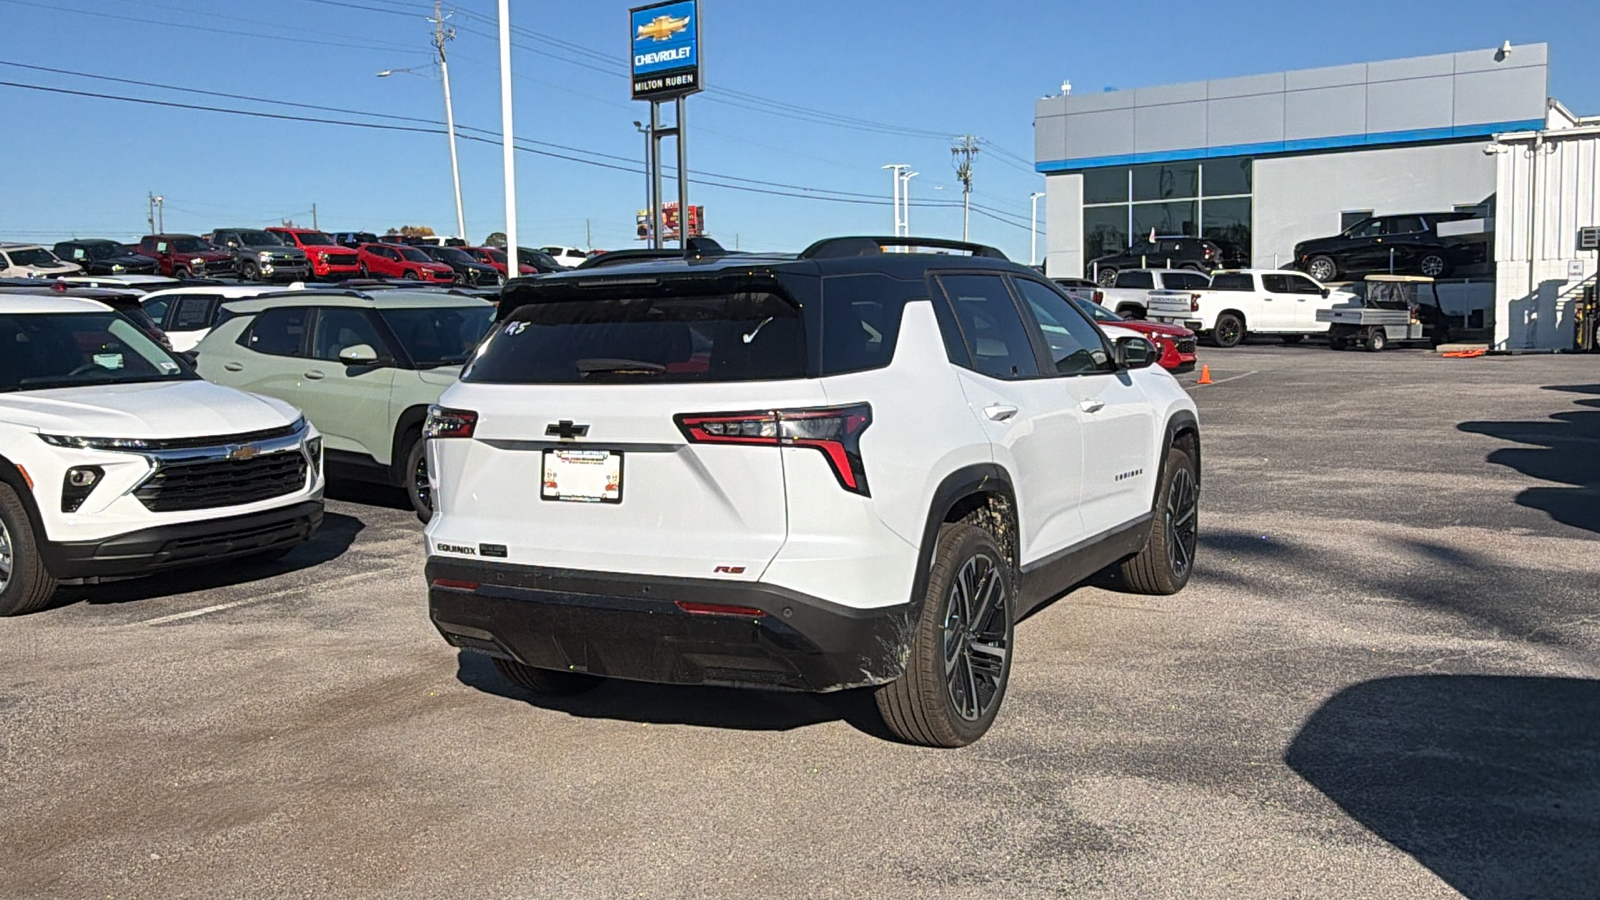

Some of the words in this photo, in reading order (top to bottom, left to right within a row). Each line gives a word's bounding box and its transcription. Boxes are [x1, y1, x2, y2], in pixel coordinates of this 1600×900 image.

[635, 46, 691, 66] CHEVROLET
[634, 79, 663, 92] MILTON
[665, 74, 694, 87] RUBEN
[437, 543, 476, 555] EQUINOX
[713, 565, 747, 574] RS
